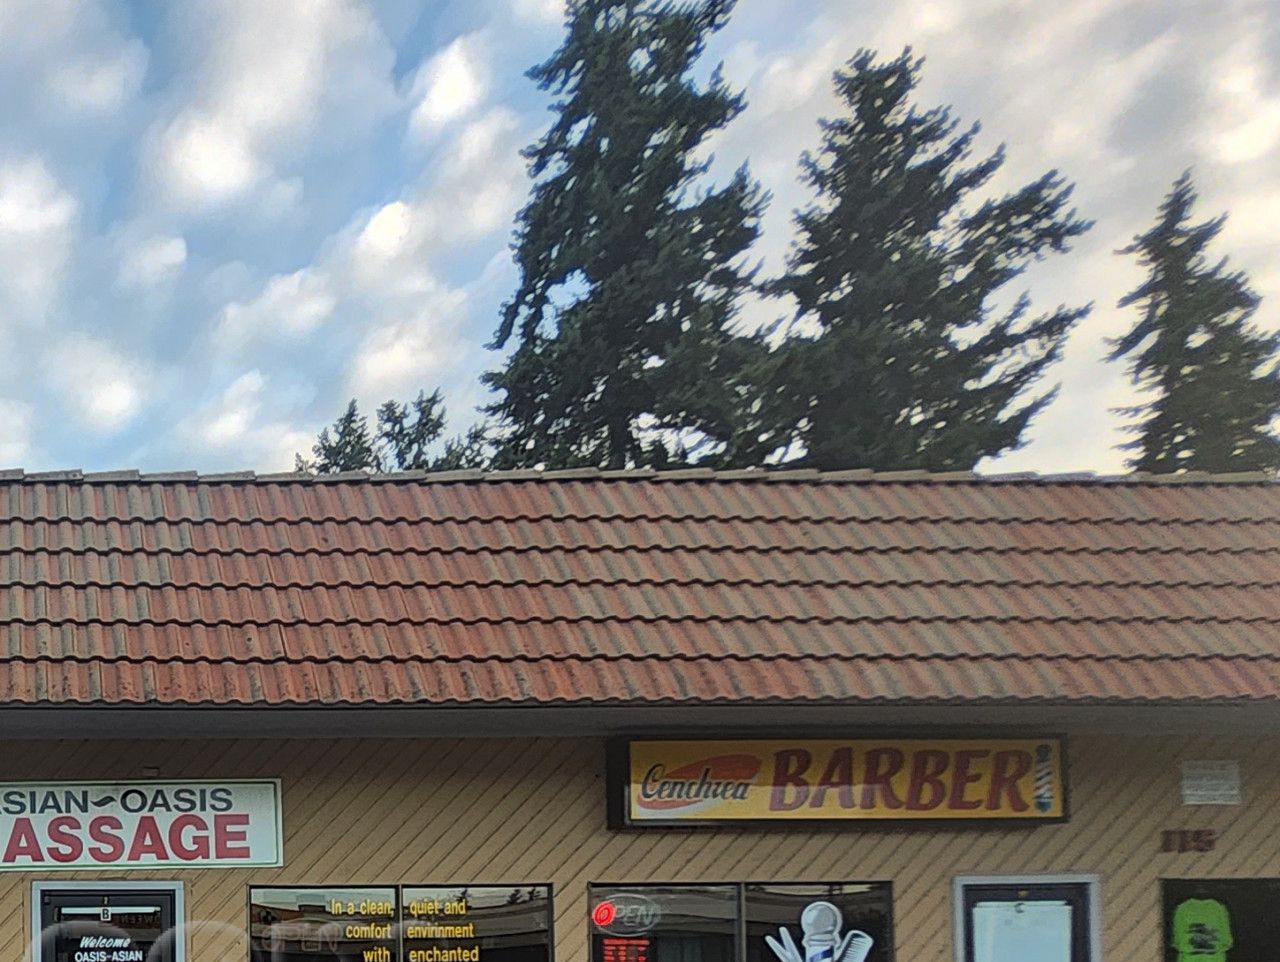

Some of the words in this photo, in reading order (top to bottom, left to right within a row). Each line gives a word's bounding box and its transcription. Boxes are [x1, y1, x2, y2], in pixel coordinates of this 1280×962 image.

[768, 746, 1034, 812] BARBER
[120, 788, 234, 814] OASIS
[102, 908, 110, 919] B
[347, 902, 355, 915] a
[410, 899, 440, 916] quiet
[444, 898, 467, 915] and
[346, 923, 392, 939] comfort
[79, 936, 131, 948] Welcome
[74, 951, 143, 962] OASIS-ASIAN
[363, 946, 391, 962] with
[409, 945, 479, 962] enchanted
